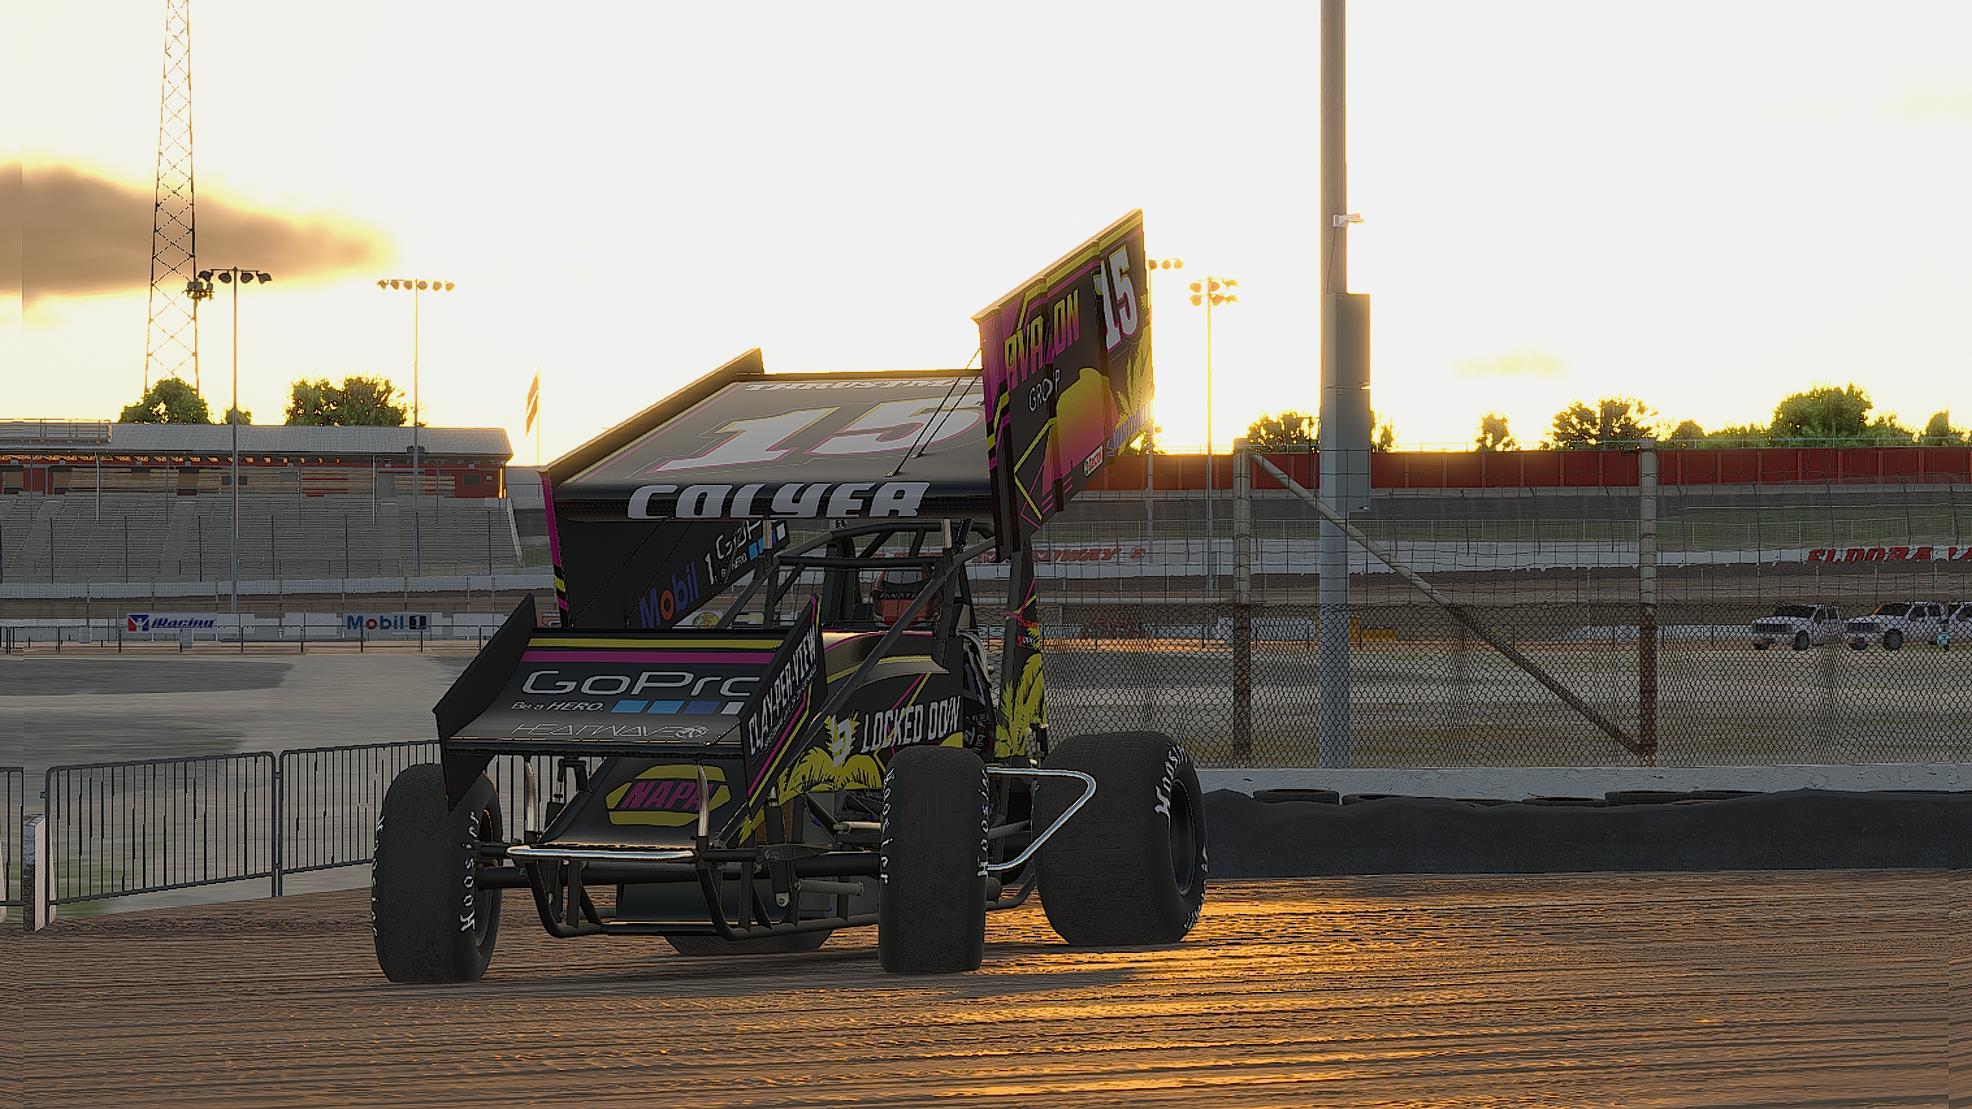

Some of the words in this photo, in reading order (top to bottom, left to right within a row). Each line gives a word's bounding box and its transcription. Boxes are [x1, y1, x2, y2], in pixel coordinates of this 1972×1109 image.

[1093, 244, 1138, 352] 15
[653, 393, 985, 472] 15
[627, 482, 930, 519] COLYER
[151, 616, 216, 629] iRacing
[346, 615, 404, 630] Mobil
[639, 560, 701, 628] Mobil
[860, 704, 924, 754] LOCKED
[927, 695, 961, 741] DOWN
